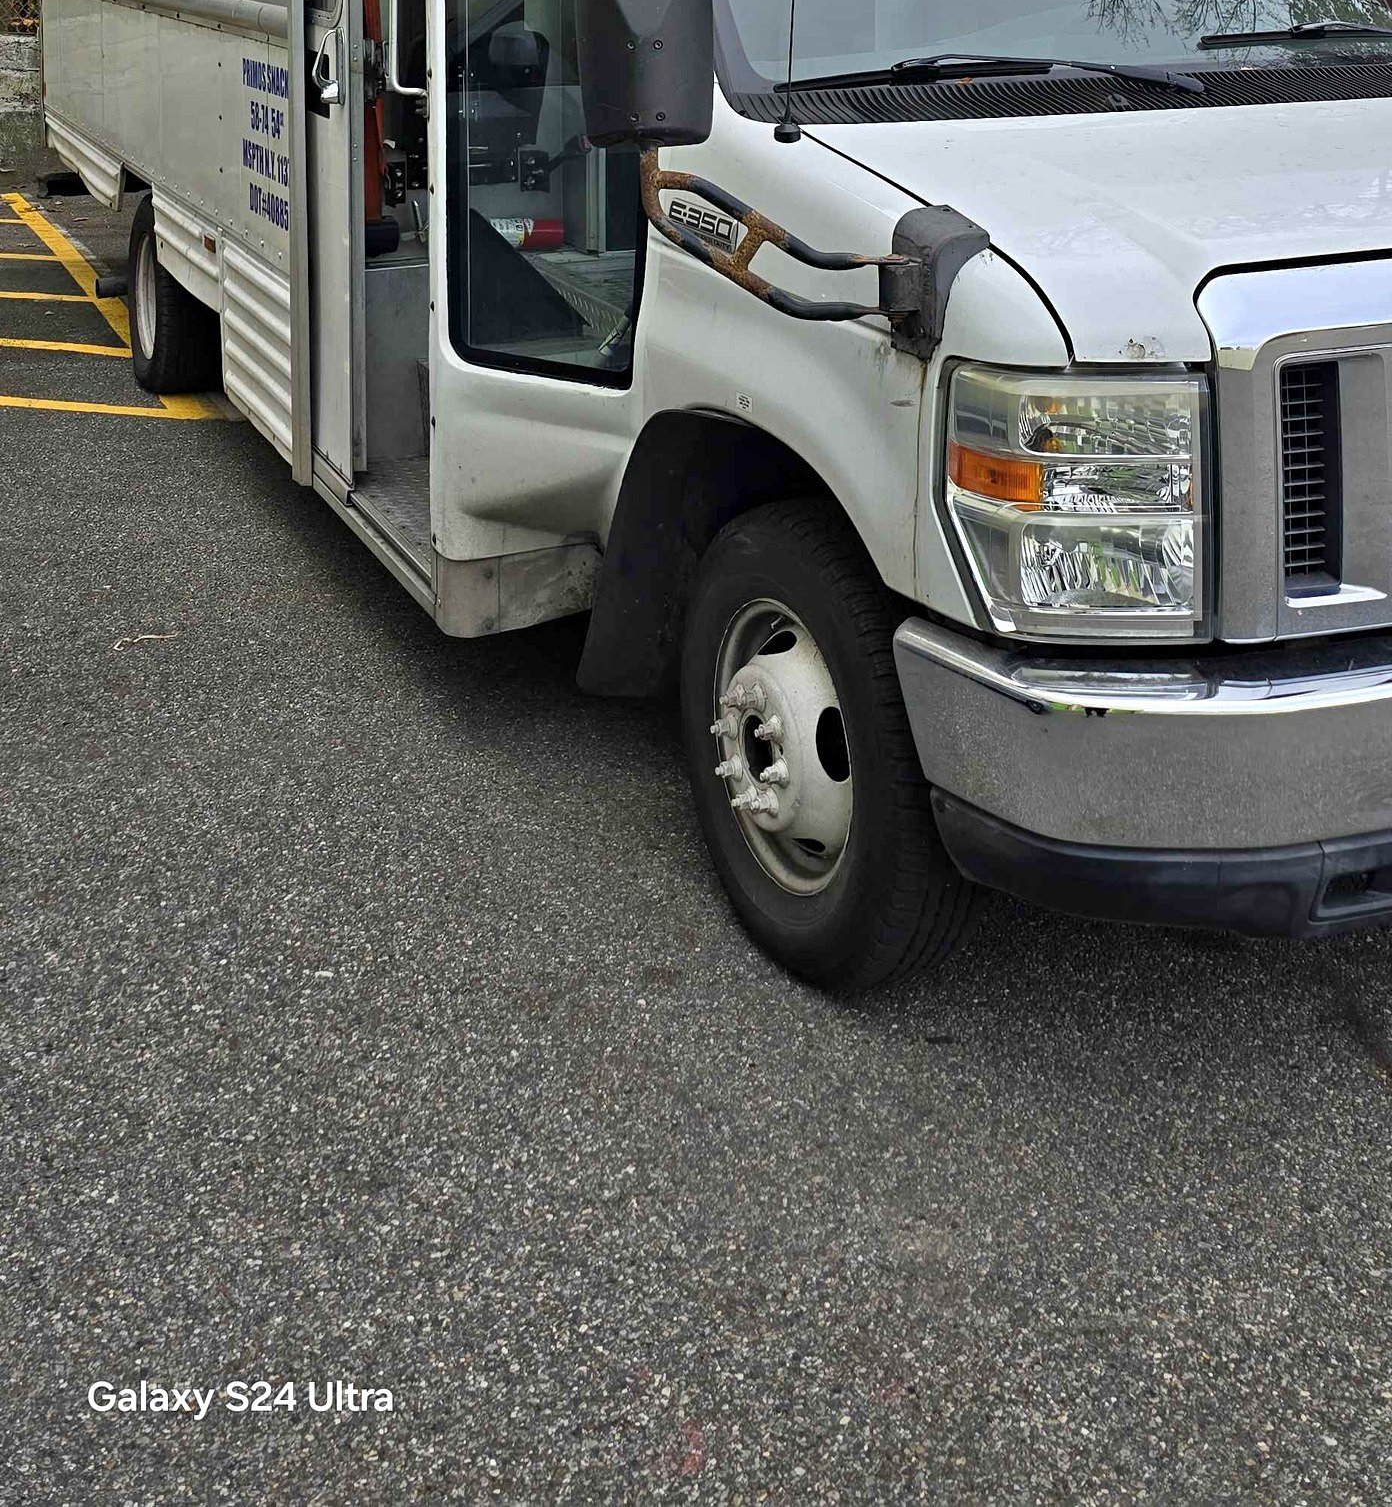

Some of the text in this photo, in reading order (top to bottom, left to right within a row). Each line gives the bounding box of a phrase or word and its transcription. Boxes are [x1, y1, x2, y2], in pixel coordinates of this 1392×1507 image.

[242, 58, 289, 99] PRIMOS SNACK
[250, 101, 269, 135] 58-74
[242, 138, 289, 187] MSPTH N.Y. 113
[669, 201, 733, 240] E-350
